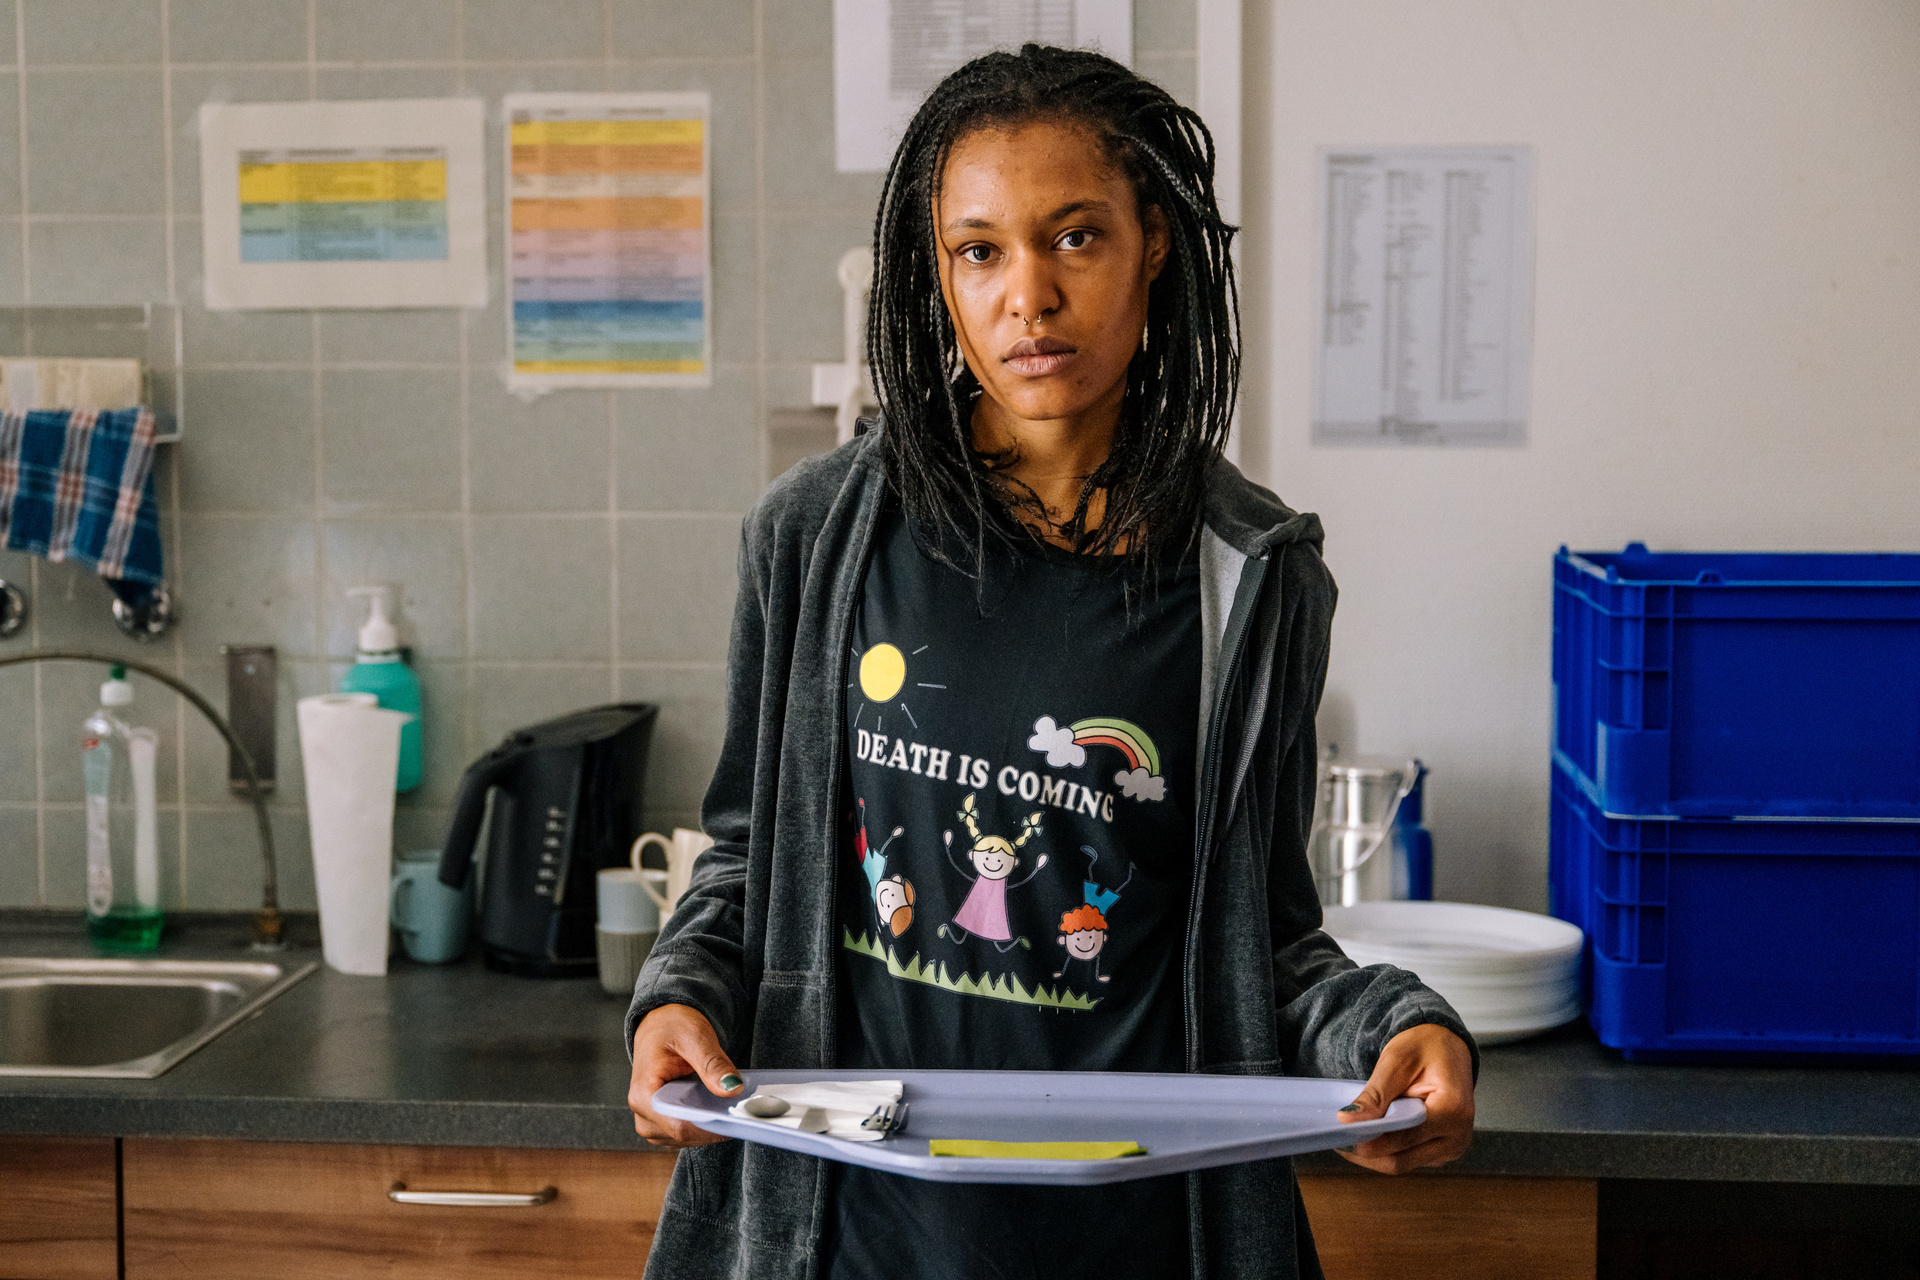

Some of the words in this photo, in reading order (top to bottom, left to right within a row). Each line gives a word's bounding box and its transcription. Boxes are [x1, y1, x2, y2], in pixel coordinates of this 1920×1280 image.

[857, 728, 951, 780] DEATH
[956, 755, 991, 789] IS
[997, 765, 1114, 823] COMING
